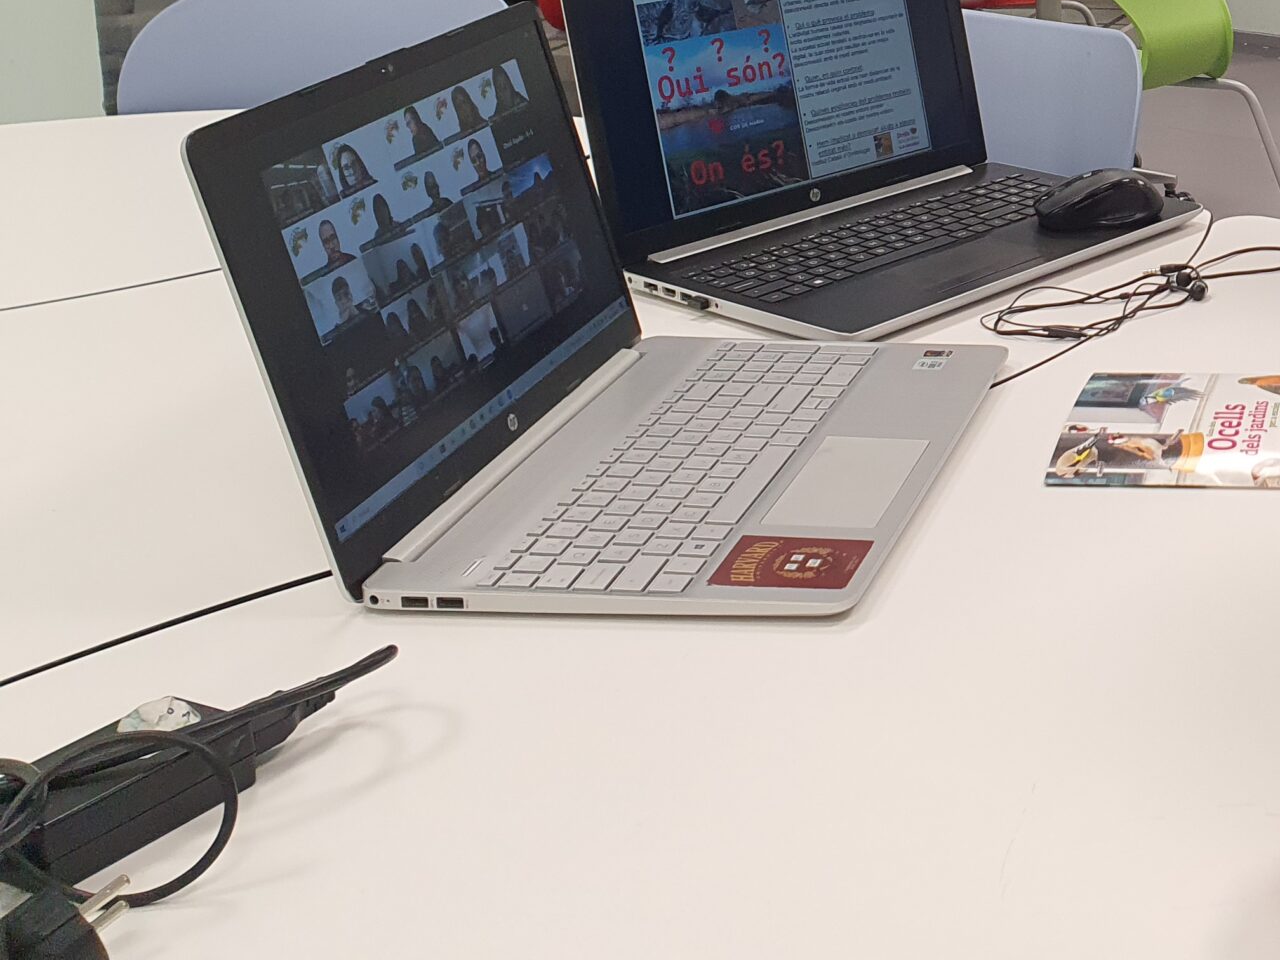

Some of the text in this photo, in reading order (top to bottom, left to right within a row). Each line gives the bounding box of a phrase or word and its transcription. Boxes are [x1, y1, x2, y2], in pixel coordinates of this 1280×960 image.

[657, 66, 710, 104] Qui
[726, 52, 785, 87] són?
[690, 159, 725, 185] On
[1207, 403, 1247, 451] Ocells
[1240, 400, 1269, 456] dels jardins
[730, 541, 780, 582] HARVARD
